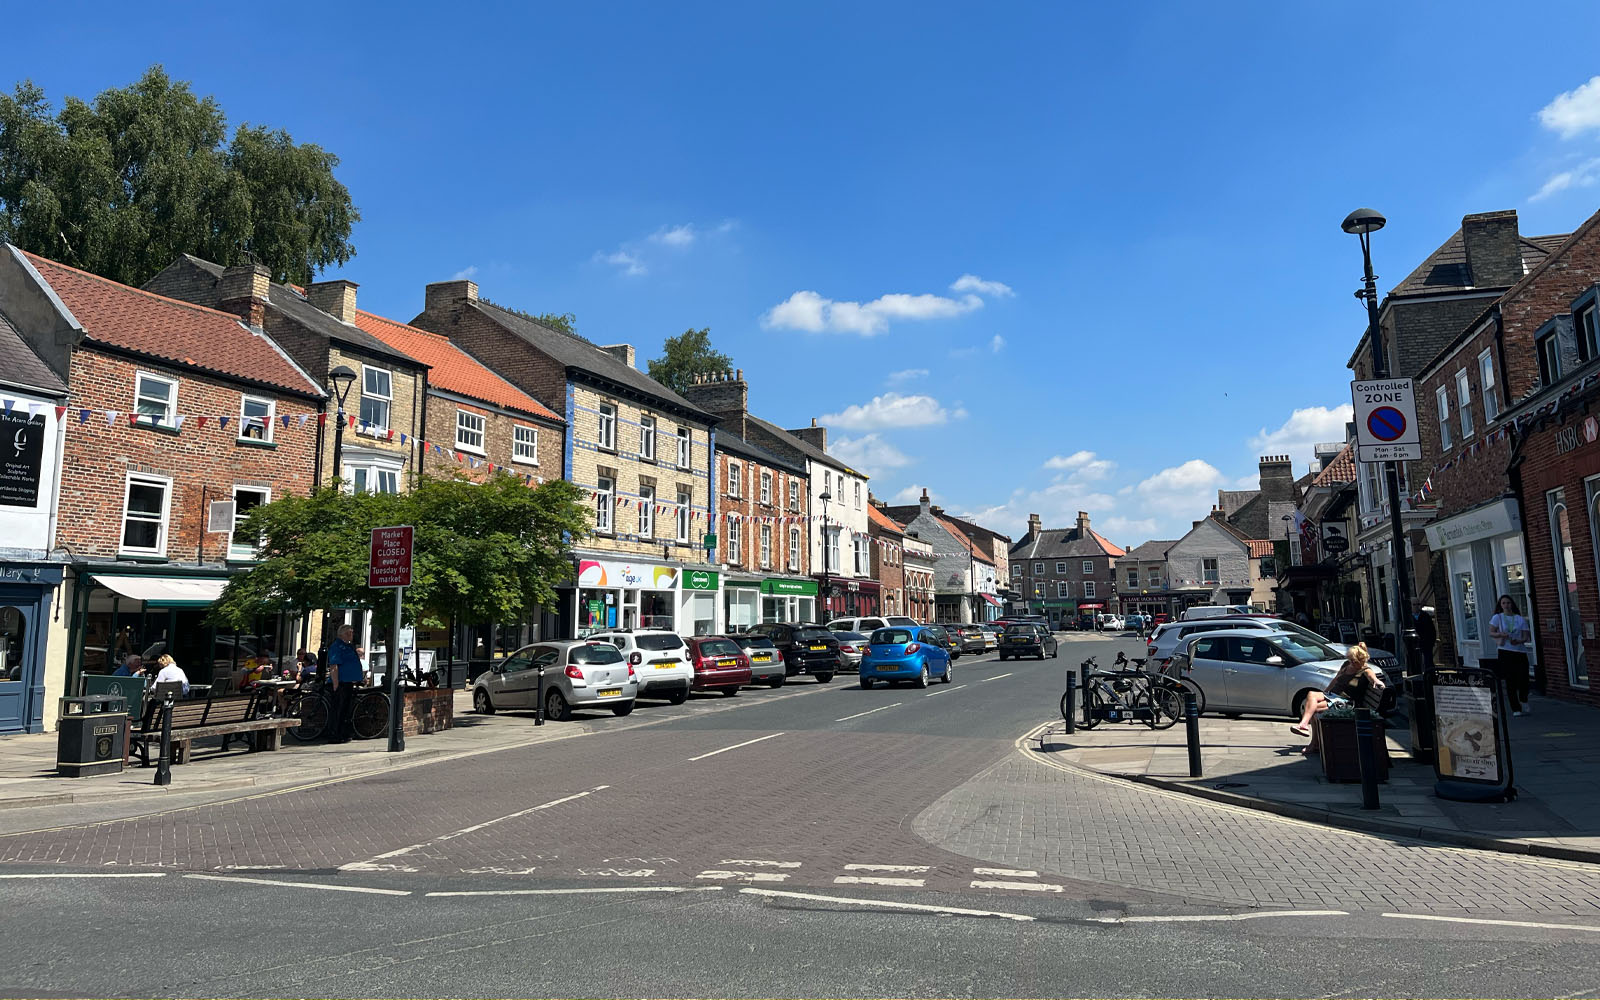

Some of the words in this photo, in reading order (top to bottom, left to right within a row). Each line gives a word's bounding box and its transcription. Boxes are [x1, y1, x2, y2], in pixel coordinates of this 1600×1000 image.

[1356, 381, 1409, 392] Controlled
[1364, 392, 1403, 403] ZONE
[1555, 424, 1584, 456] HSBC
[381, 531, 404, 539] Market
[377, 548, 406, 557] CLOSED
[372, 566, 398, 574] Tuesday
[378, 575, 402, 583] market
